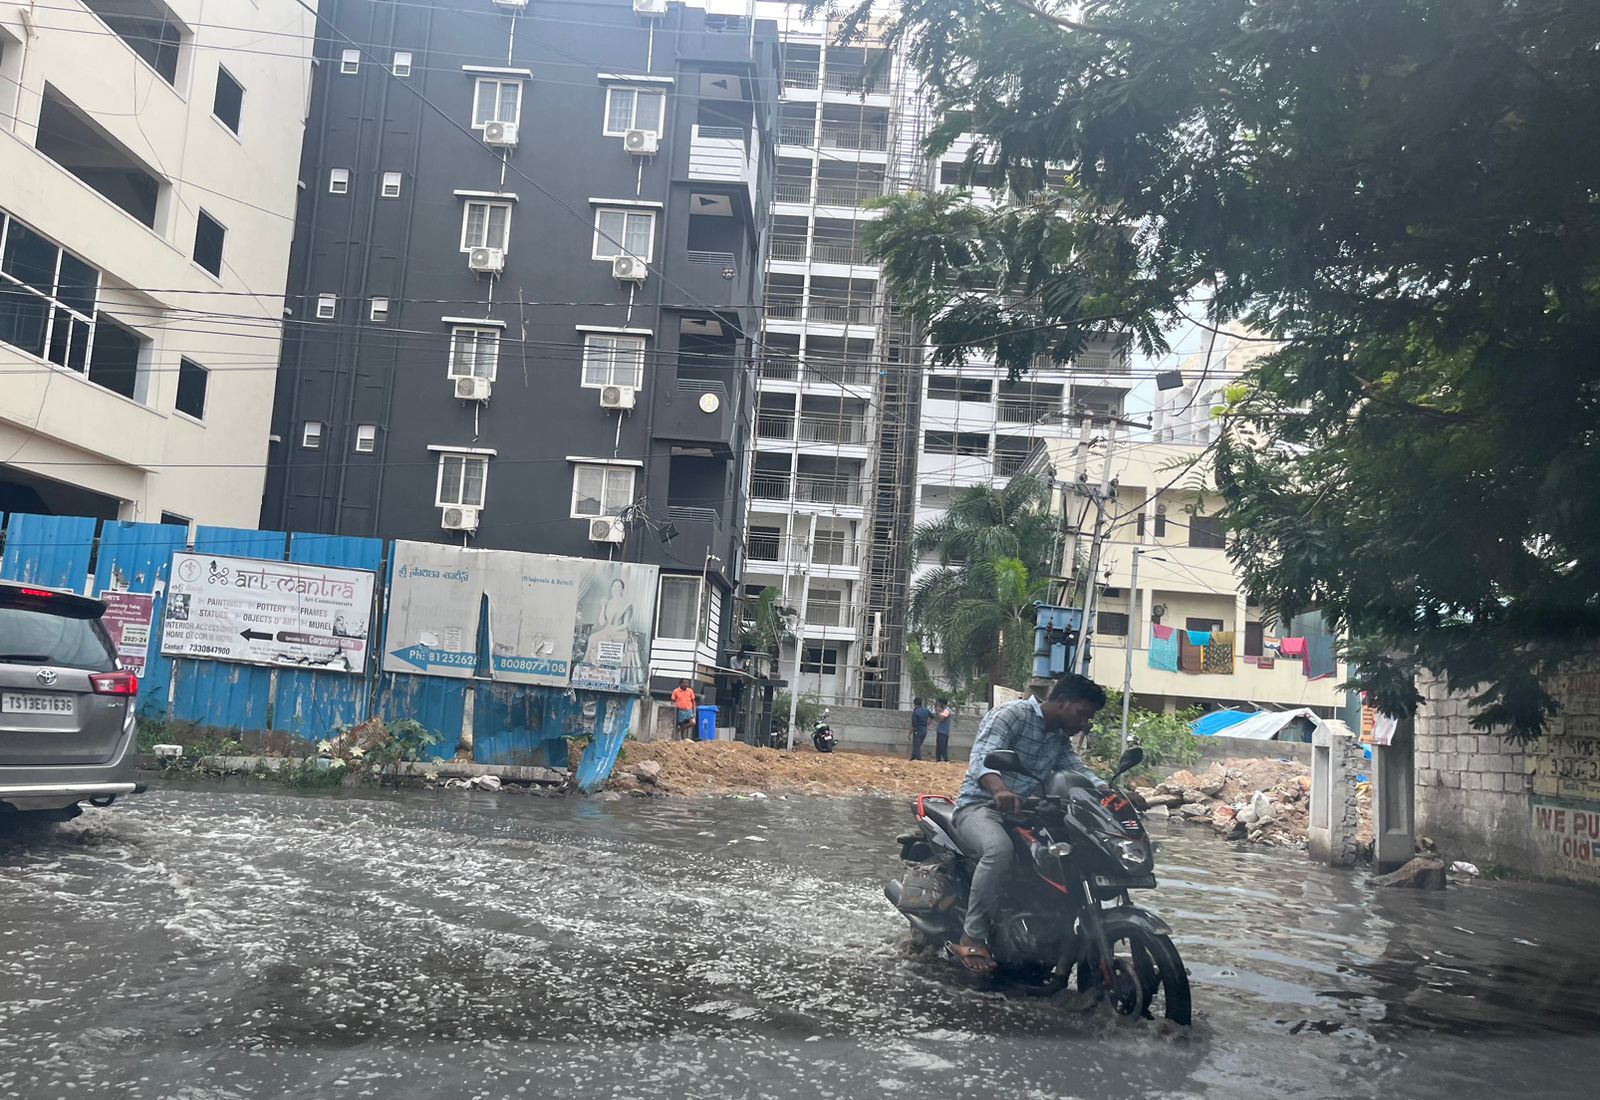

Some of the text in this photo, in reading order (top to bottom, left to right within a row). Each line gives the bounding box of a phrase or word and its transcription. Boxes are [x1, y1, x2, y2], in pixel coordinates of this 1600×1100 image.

[256, 601, 287, 613] POTTERY
[300, 607, 328, 618] FRAMES
[165, 621, 194, 631] INTERIOR
[198, 609, 229, 620] STATUES
[242, 613, 274, 625] OBJECTS
[309, 620, 333, 631] MUREL
[166, 631, 184, 640] HOME
[309, 635, 339, 647] Corporate
[164, 644, 184, 652] Contact
[409, 649, 426, 661] Ph:
[1536, 806, 1565, 833] WE
